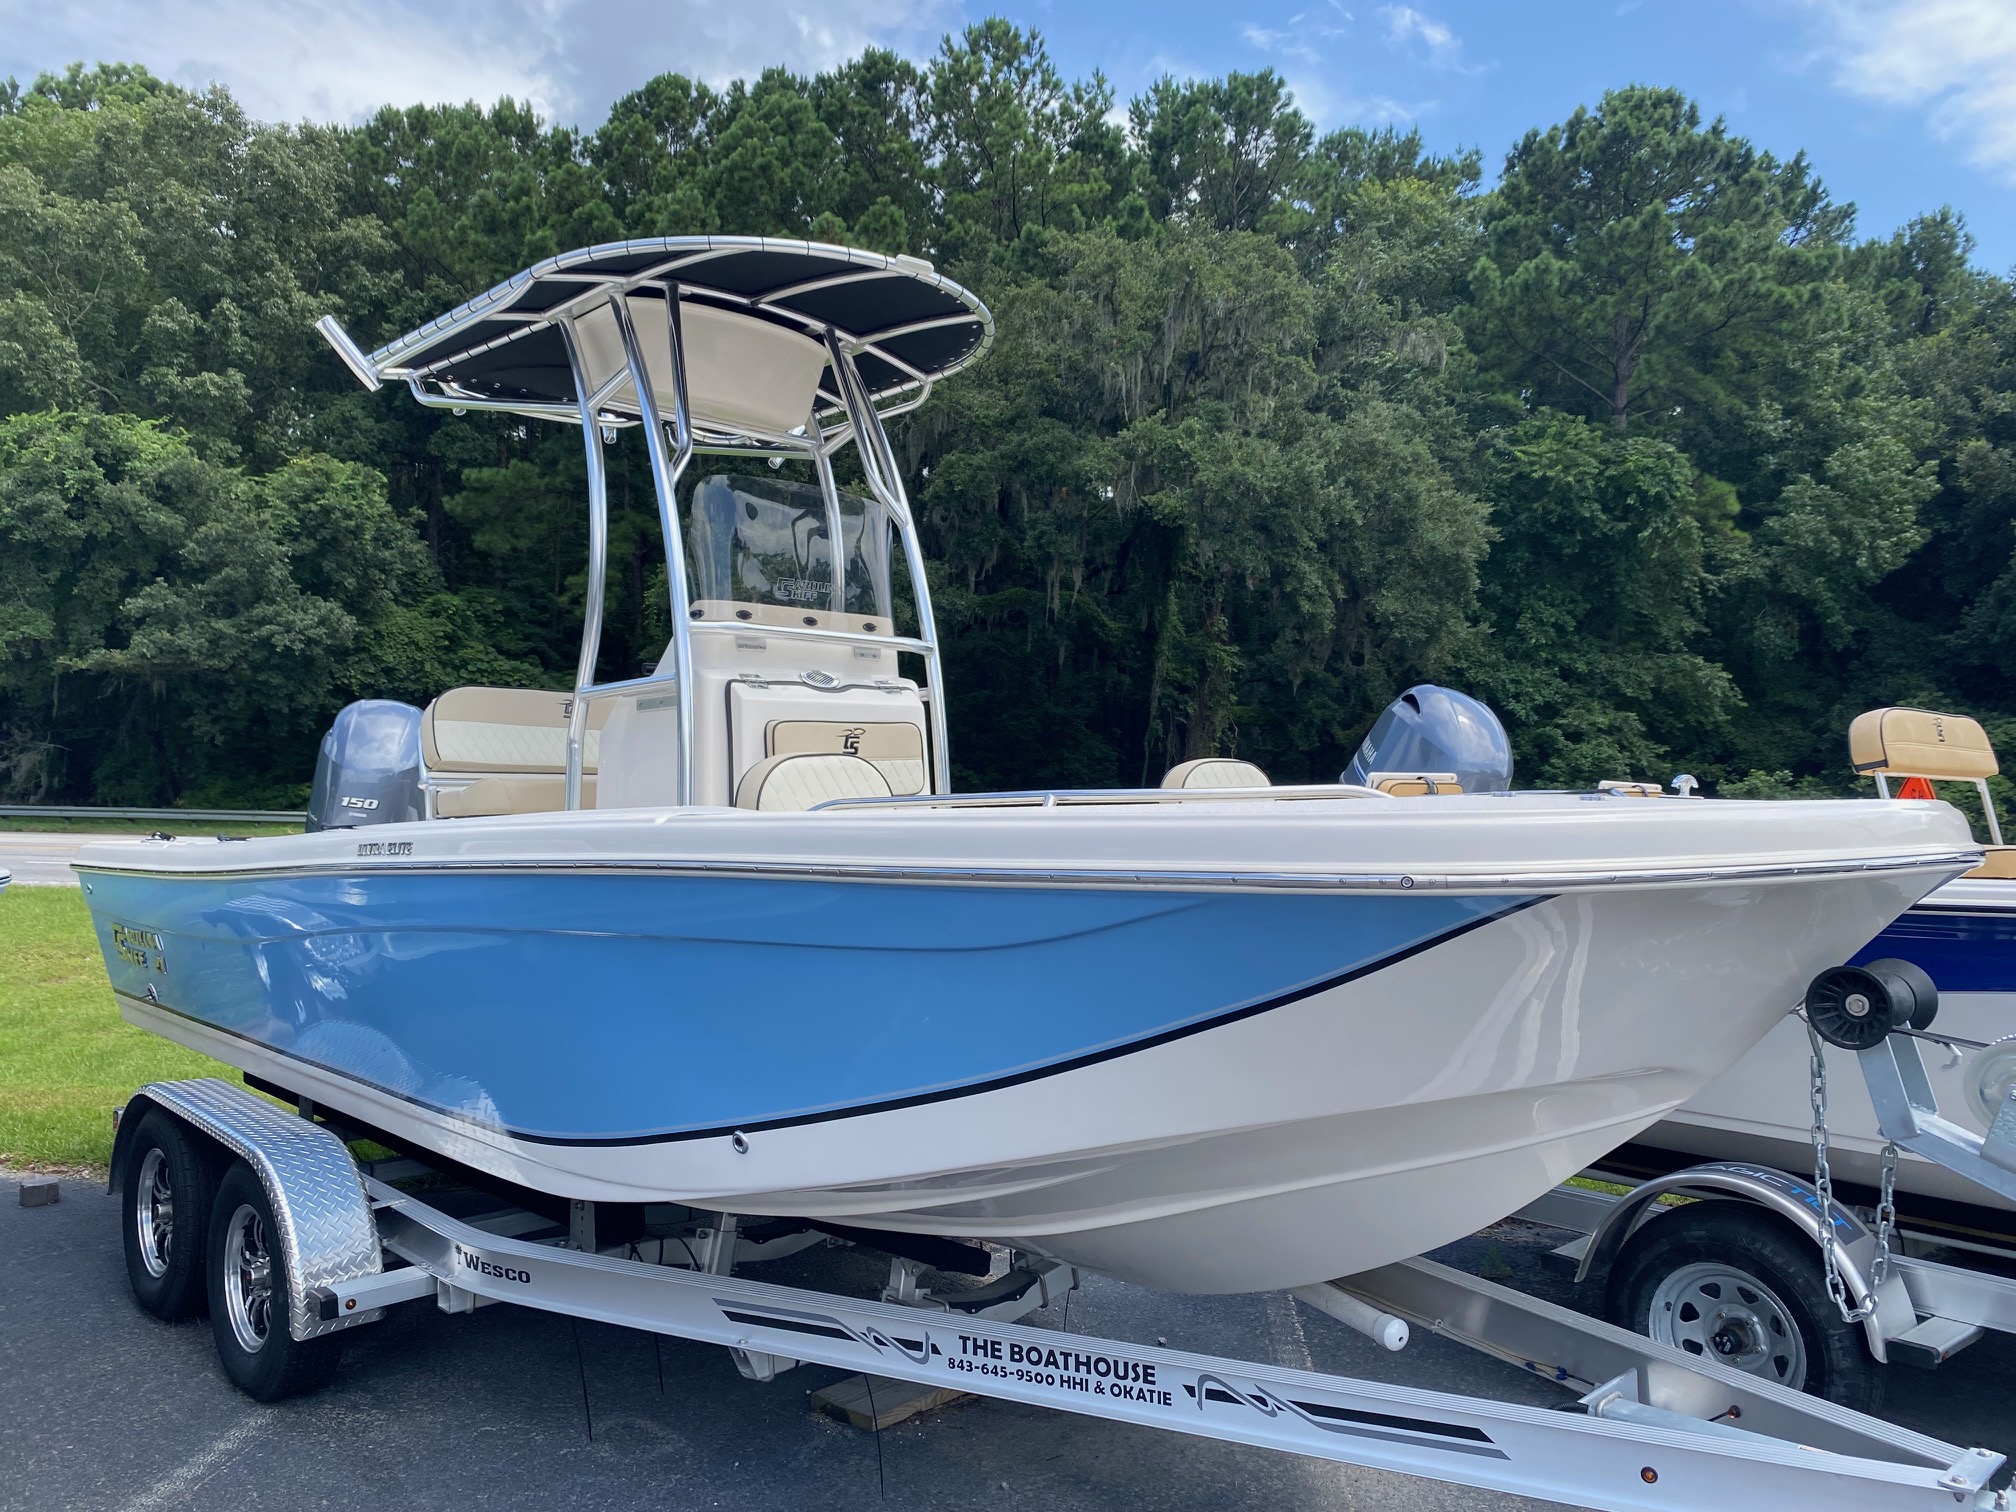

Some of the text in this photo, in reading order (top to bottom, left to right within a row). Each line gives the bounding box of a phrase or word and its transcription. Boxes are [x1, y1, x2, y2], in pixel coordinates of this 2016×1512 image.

[341, 796, 379, 810] 150
[462, 1250, 531, 1284] WESCO
[958, 1334, 1157, 1386] THE BOATHOUSE
[947, 1357, 1173, 1407] 843-645-9500 HHI & OKATIE
